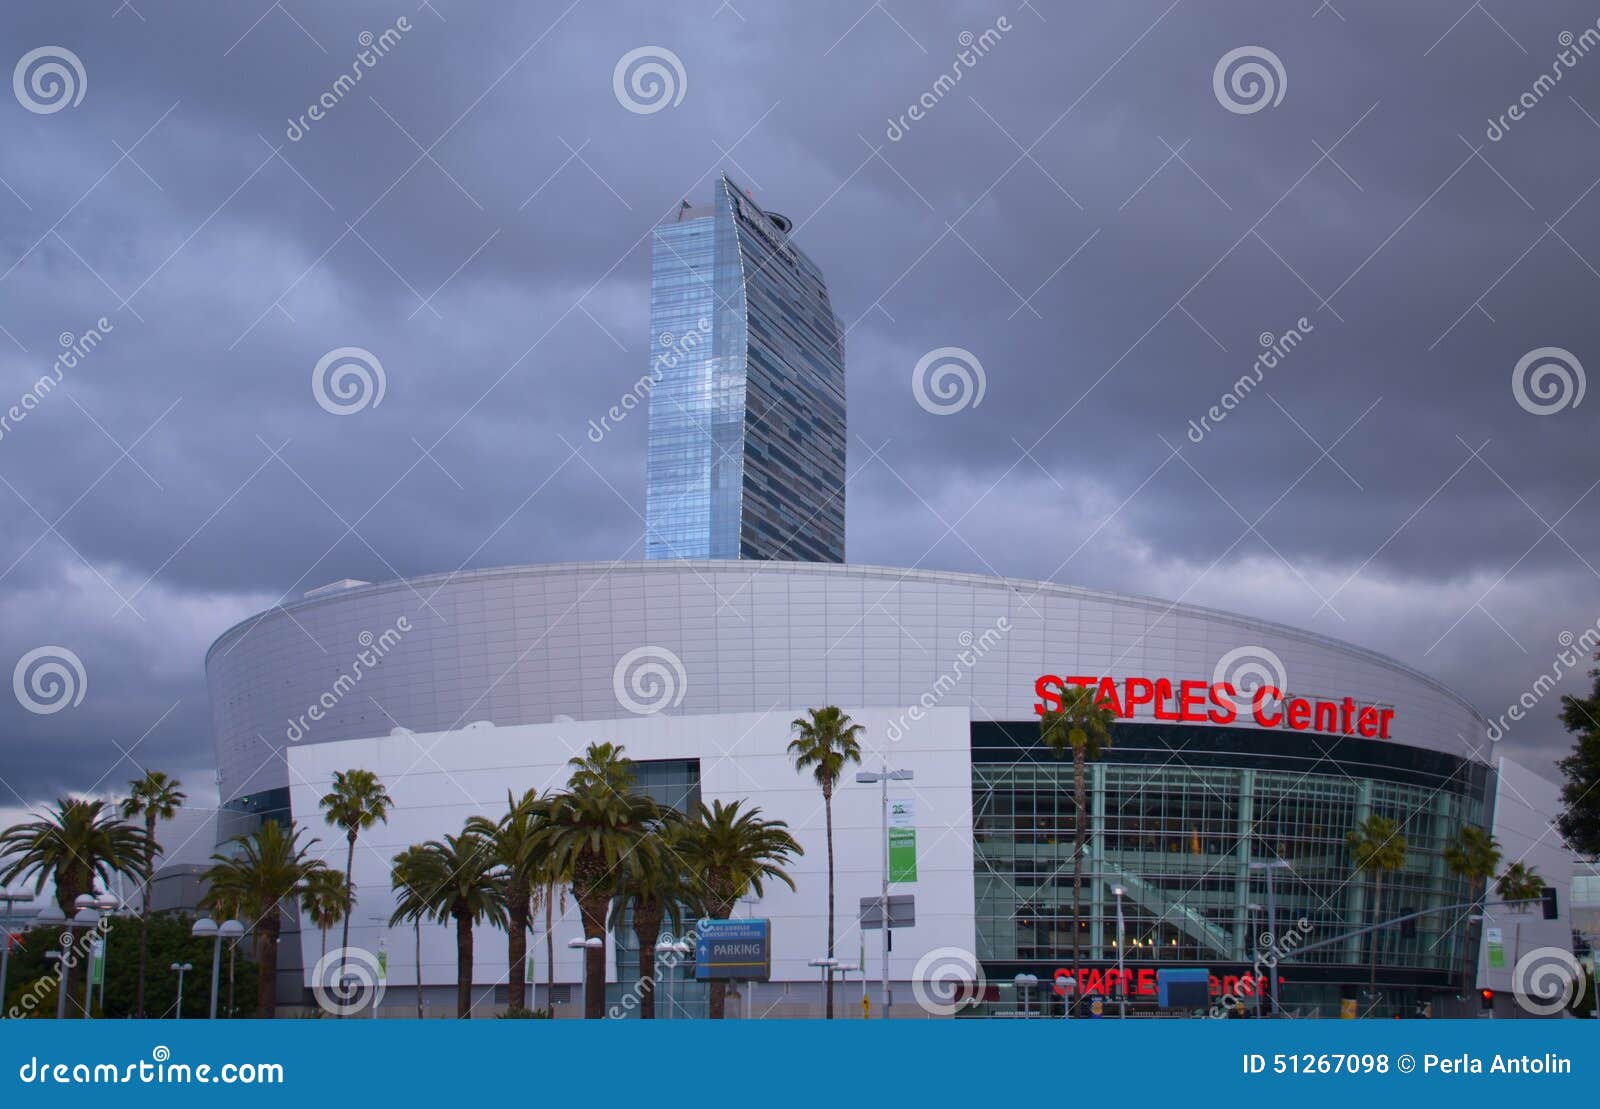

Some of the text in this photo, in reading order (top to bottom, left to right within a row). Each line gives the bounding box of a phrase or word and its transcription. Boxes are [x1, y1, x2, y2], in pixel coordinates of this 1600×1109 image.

[1034, 674, 1395, 739] STAPLES Center
[714, 943, 760, 955] PARKING
[1053, 968, 1160, 995] STAPLE
